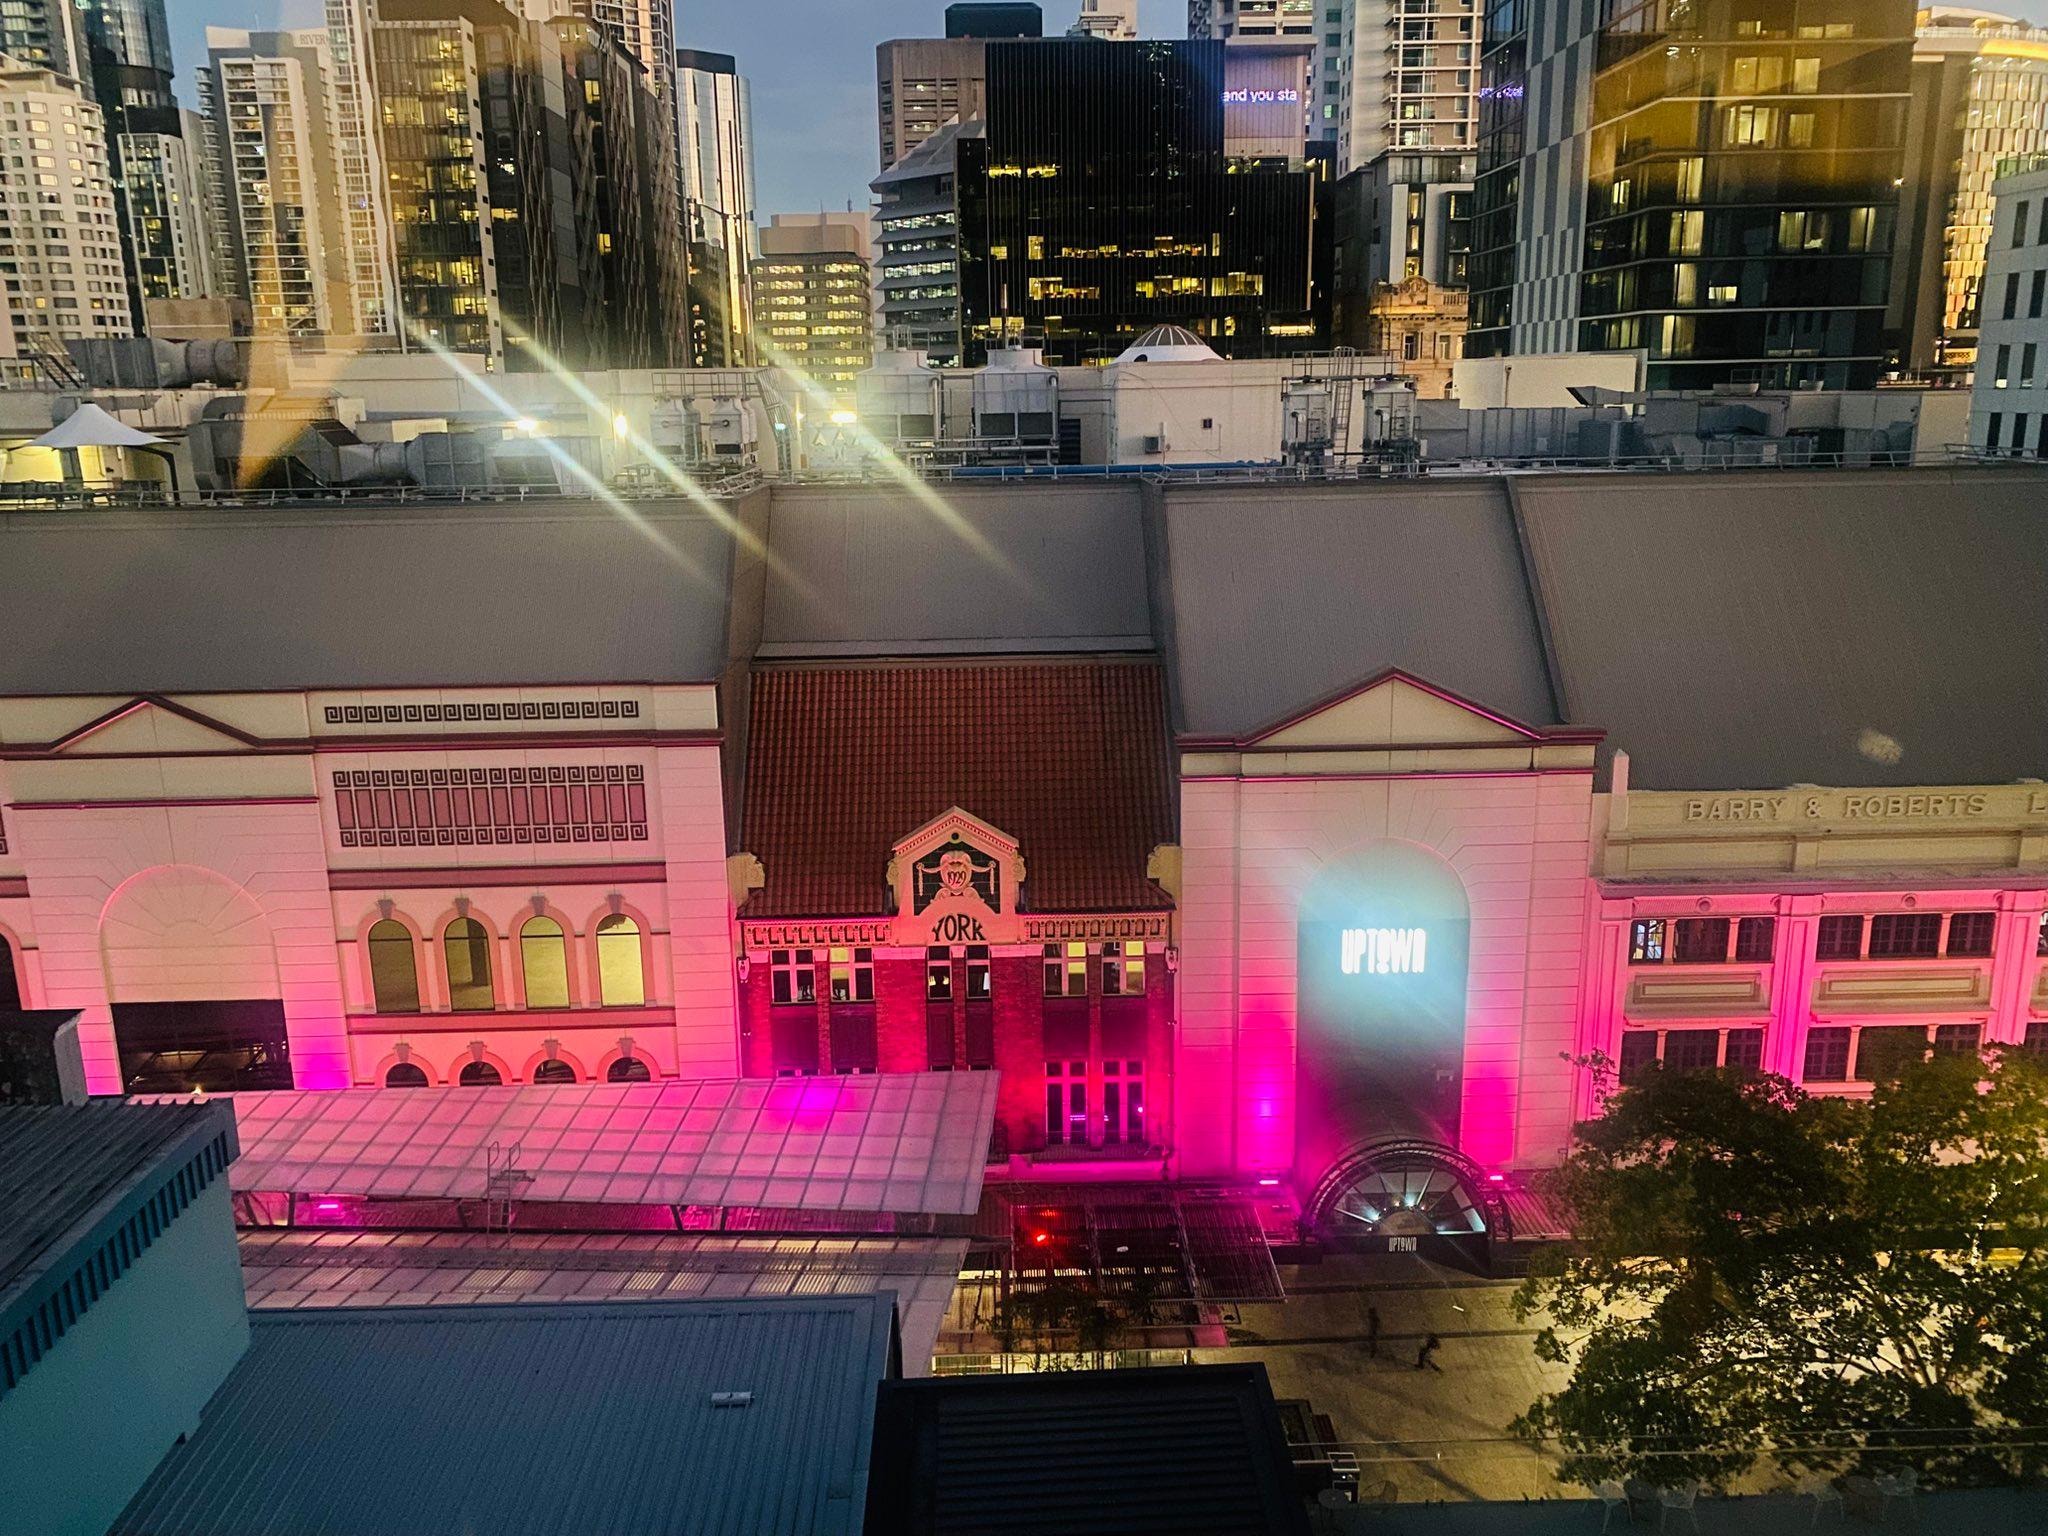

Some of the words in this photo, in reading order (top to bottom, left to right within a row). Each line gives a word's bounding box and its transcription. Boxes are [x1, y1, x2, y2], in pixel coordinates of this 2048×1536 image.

[1223, 88, 1247, 102] and
[1250, 90, 1275, 103] you
[1277, 88, 1297, 101] sta
[1687, 796, 1787, 821] BARRY
[1805, 796, 1823, 819] &
[1843, 792, 1988, 819] ROBERTS
[947, 870, 967, 887] 1929
[931, 913, 987, 942] YORK
[1341, 927, 1427, 975] UPTOWN
[1388, 1236, 1417, 1252] UPTOWN
